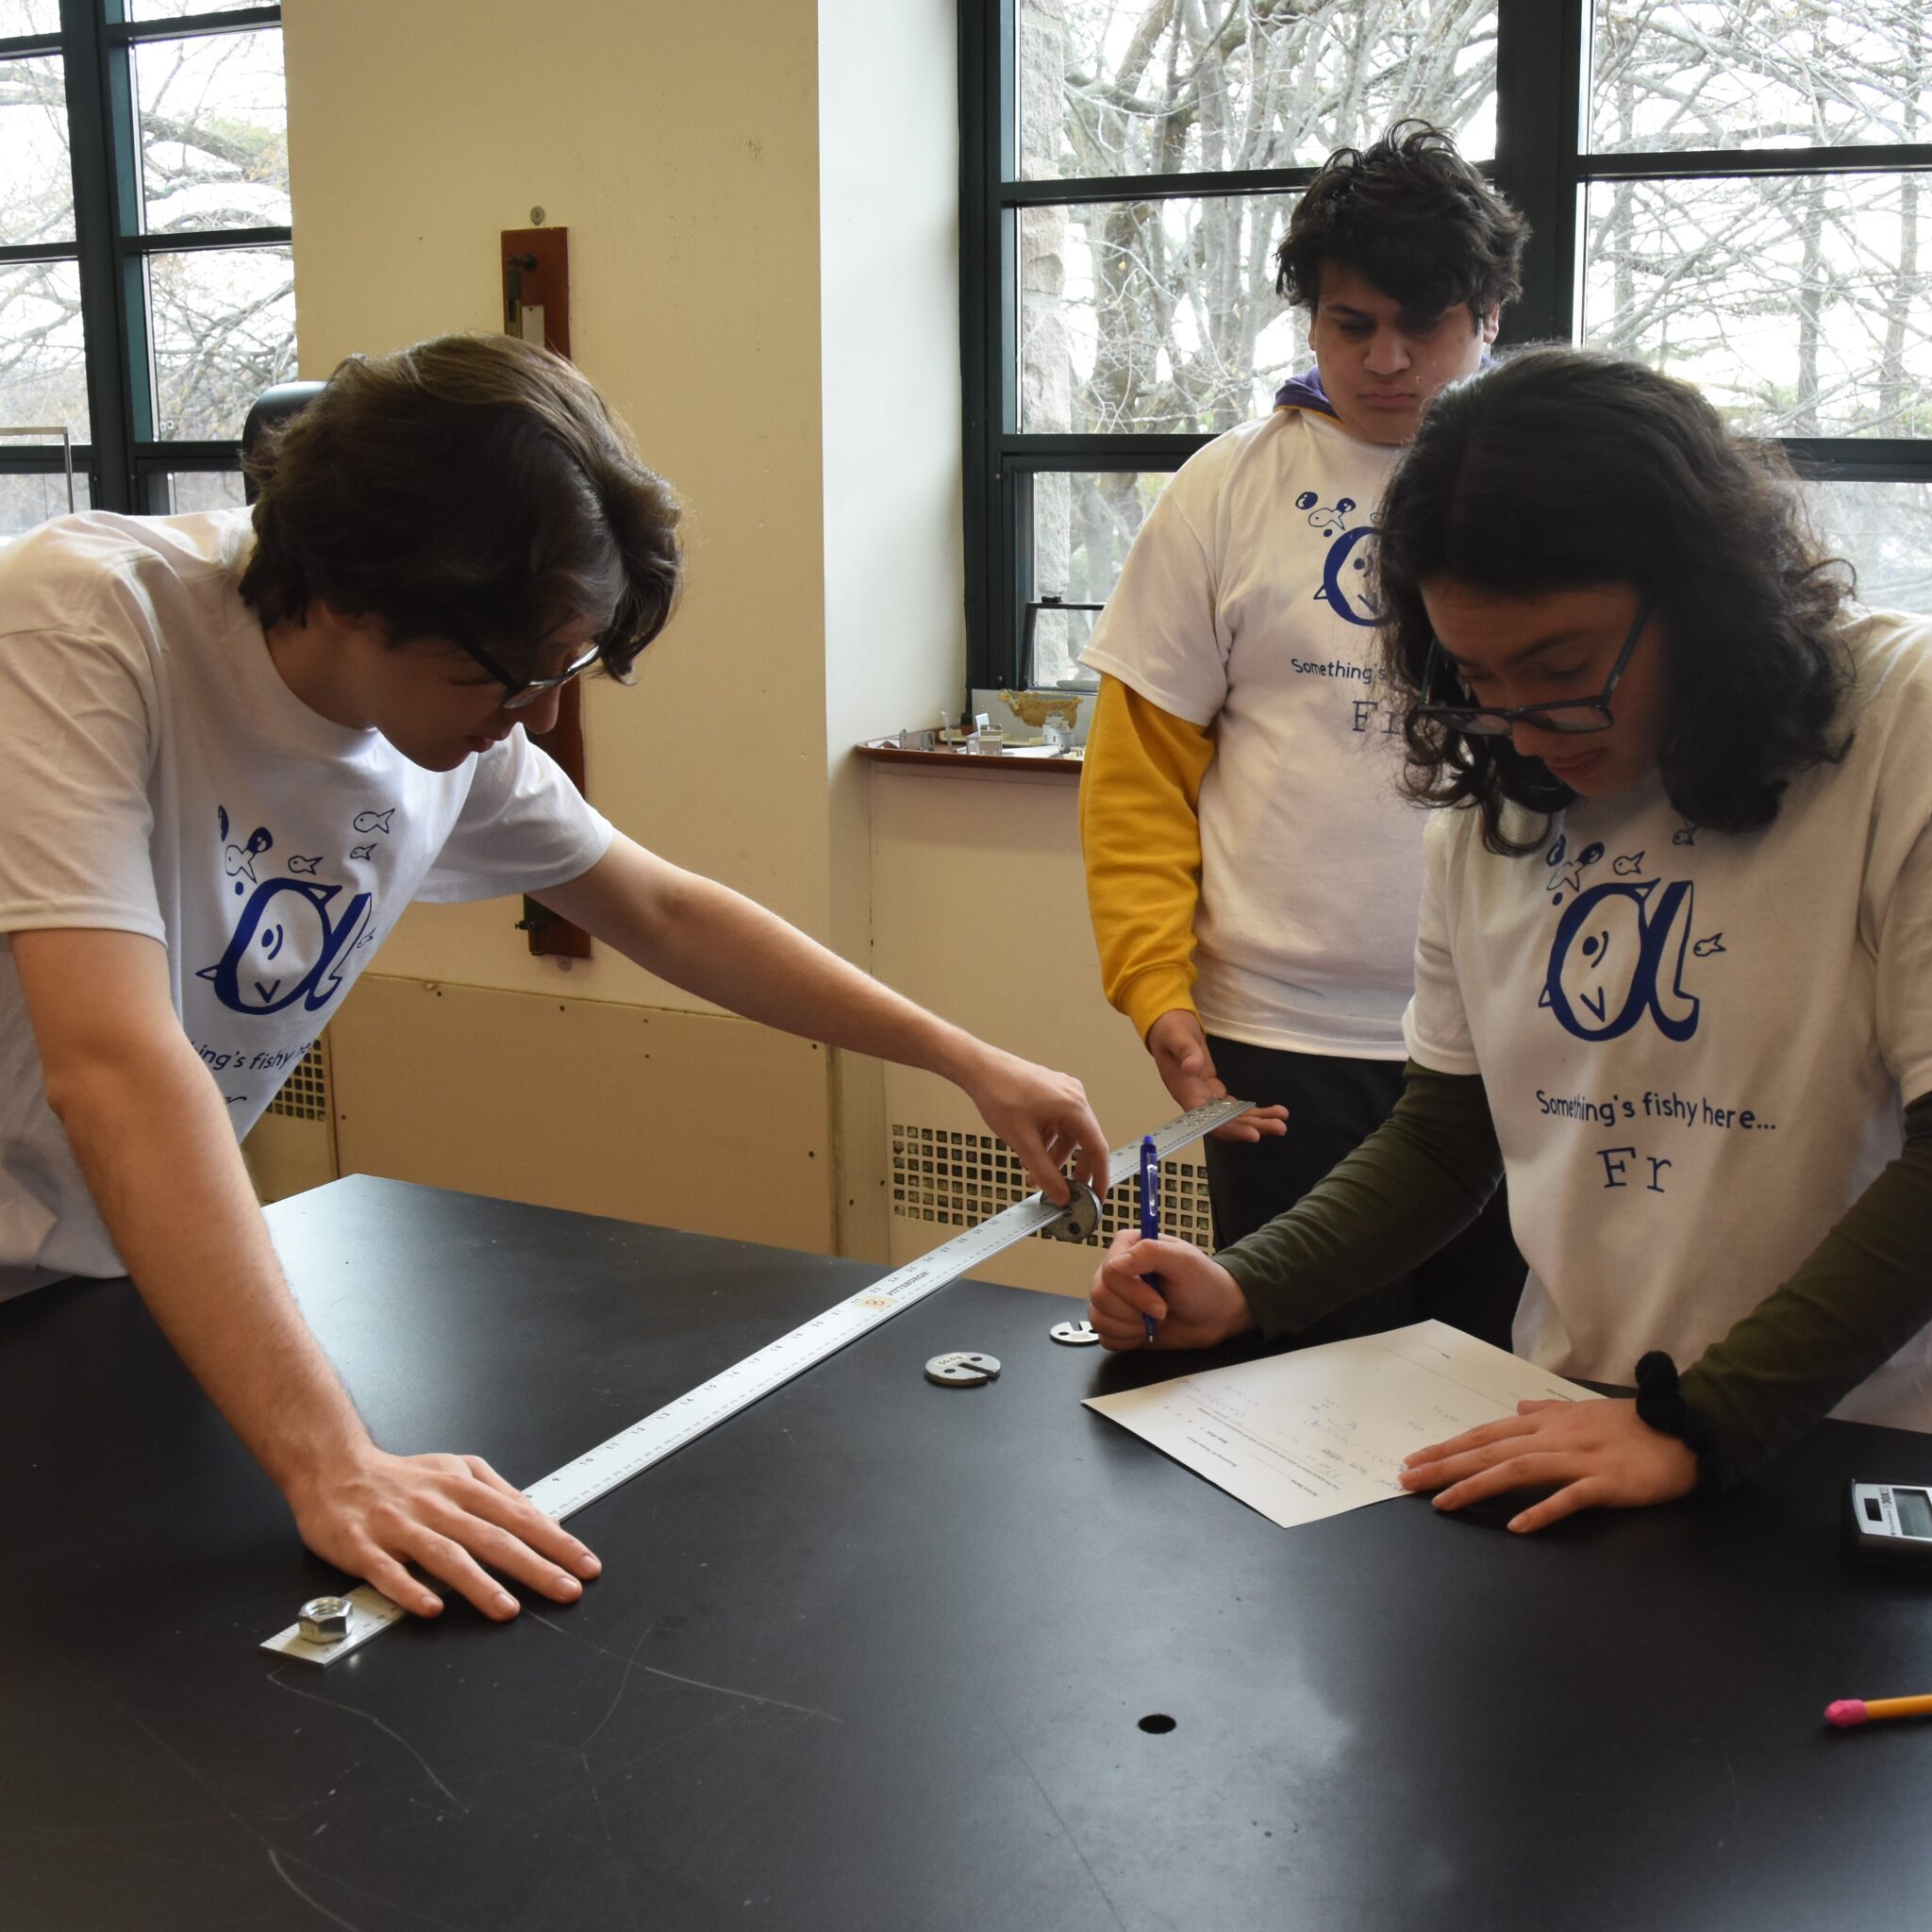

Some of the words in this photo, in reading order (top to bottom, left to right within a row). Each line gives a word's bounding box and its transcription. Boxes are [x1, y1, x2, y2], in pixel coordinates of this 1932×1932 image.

[1291, 658, 1387, 684] Something's
[249, 1052, 295, 1070] fishy
[1536, 1090, 1635, 1127] Something's
[1642, 1091, 1698, 1127] fishy
[1703, 1097, 1776, 1129] here...
[1596, 1146, 1673, 1193] Fr
